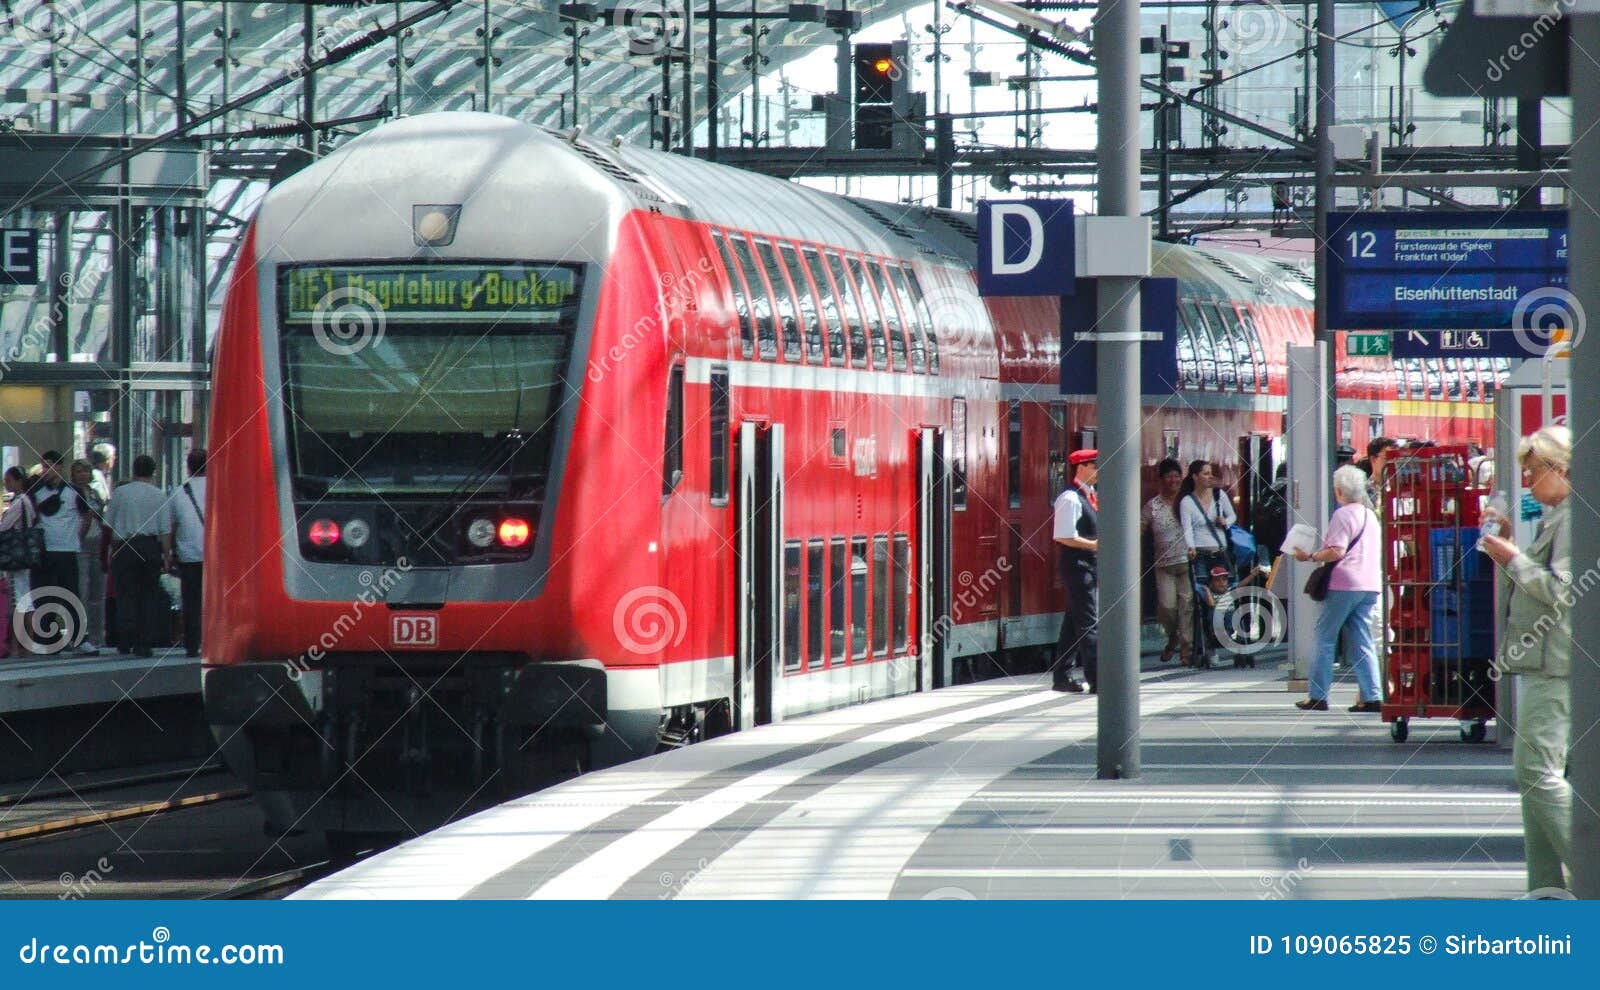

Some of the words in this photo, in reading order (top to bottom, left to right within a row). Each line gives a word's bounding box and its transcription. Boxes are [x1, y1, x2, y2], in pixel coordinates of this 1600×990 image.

[4, 230, 31, 271] E
[991, 203, 1044, 274] D
[1346, 231, 1376, 258] 12
[1394, 252, 1438, 261] Frankfurt
[1394, 286, 1518, 301] Eisenhüttenstadt
[394, 617, 435, 643] DB
